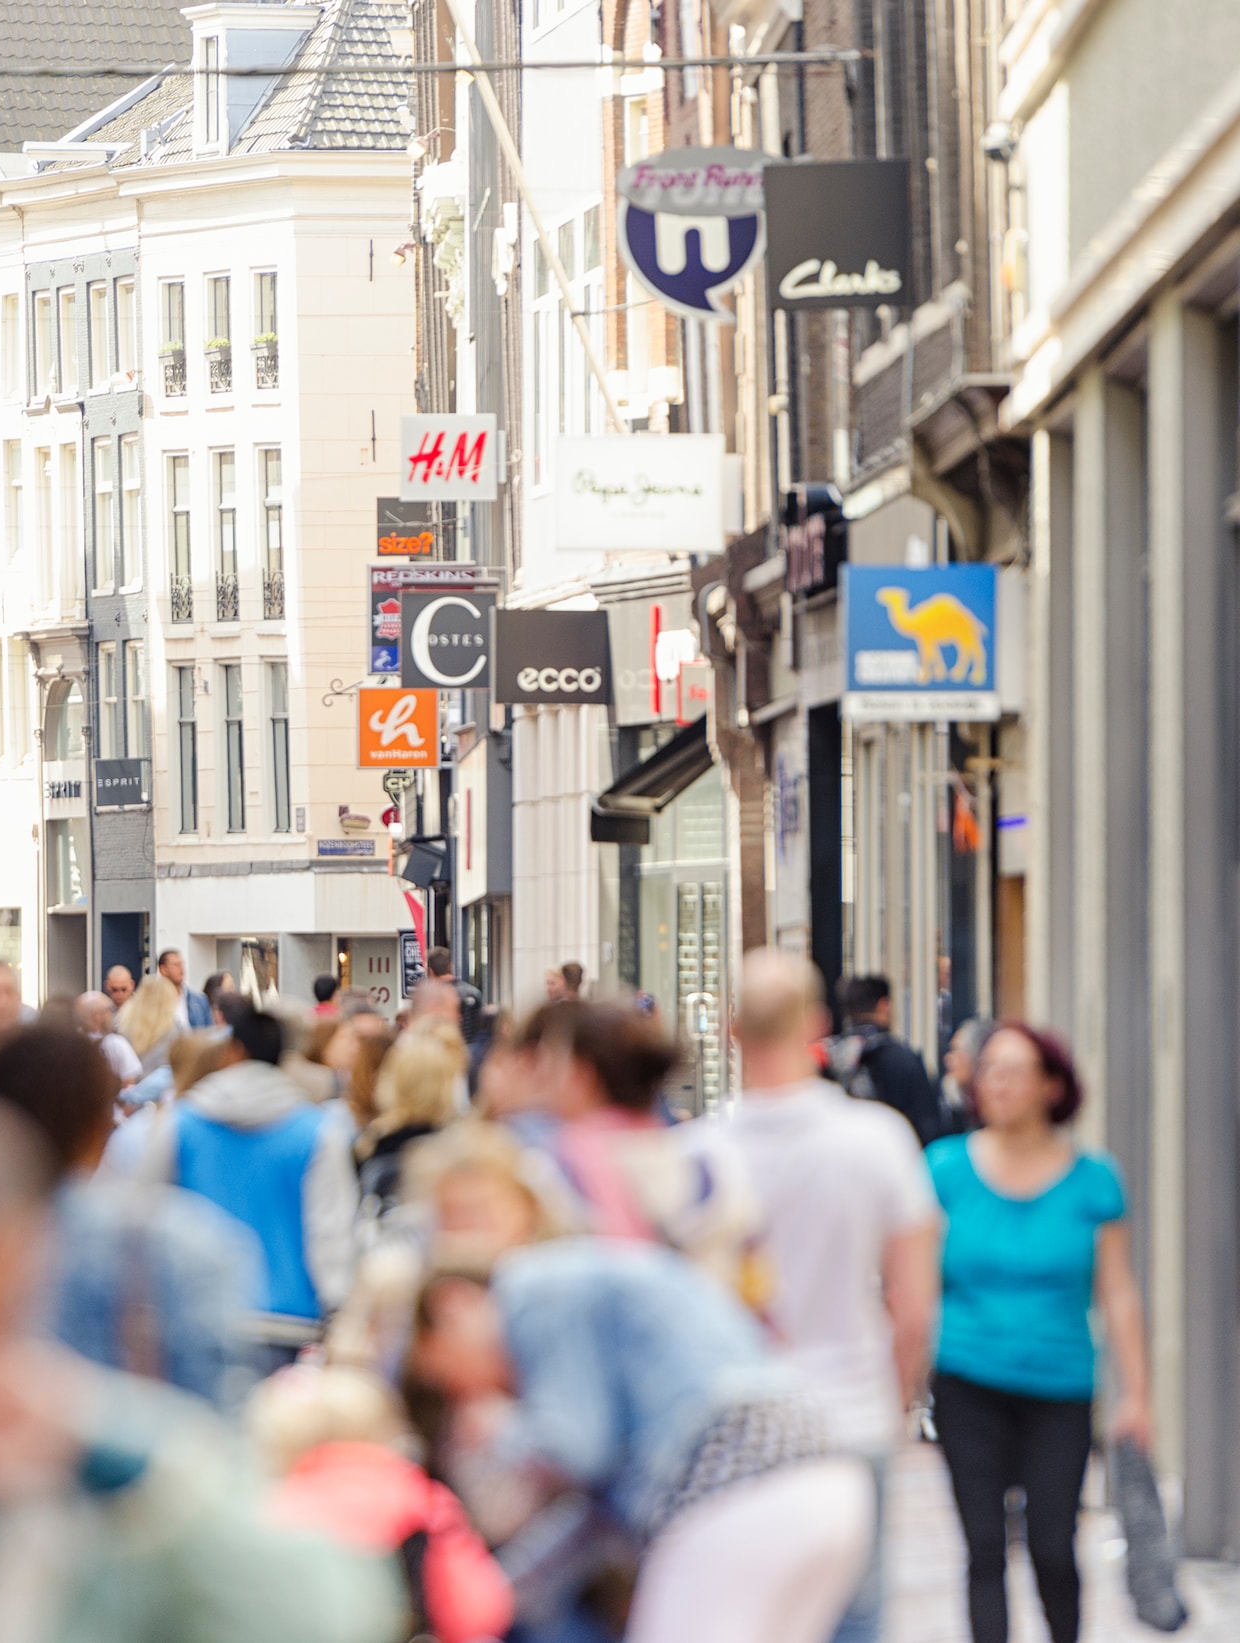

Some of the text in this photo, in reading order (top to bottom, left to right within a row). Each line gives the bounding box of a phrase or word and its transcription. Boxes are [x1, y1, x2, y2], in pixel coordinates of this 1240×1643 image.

[779, 258, 902, 300] Clarks
[408, 430, 489, 485] H&M
[573, 467, 628, 504] Pepe
[378, 531, 434, 552] size?
[372, 569, 476, 585] REDSKINS
[517, 666, 602, 693] ecco
[369, 749, 428, 759] vanHaren
[97, 775, 140, 788] ESPRIT
